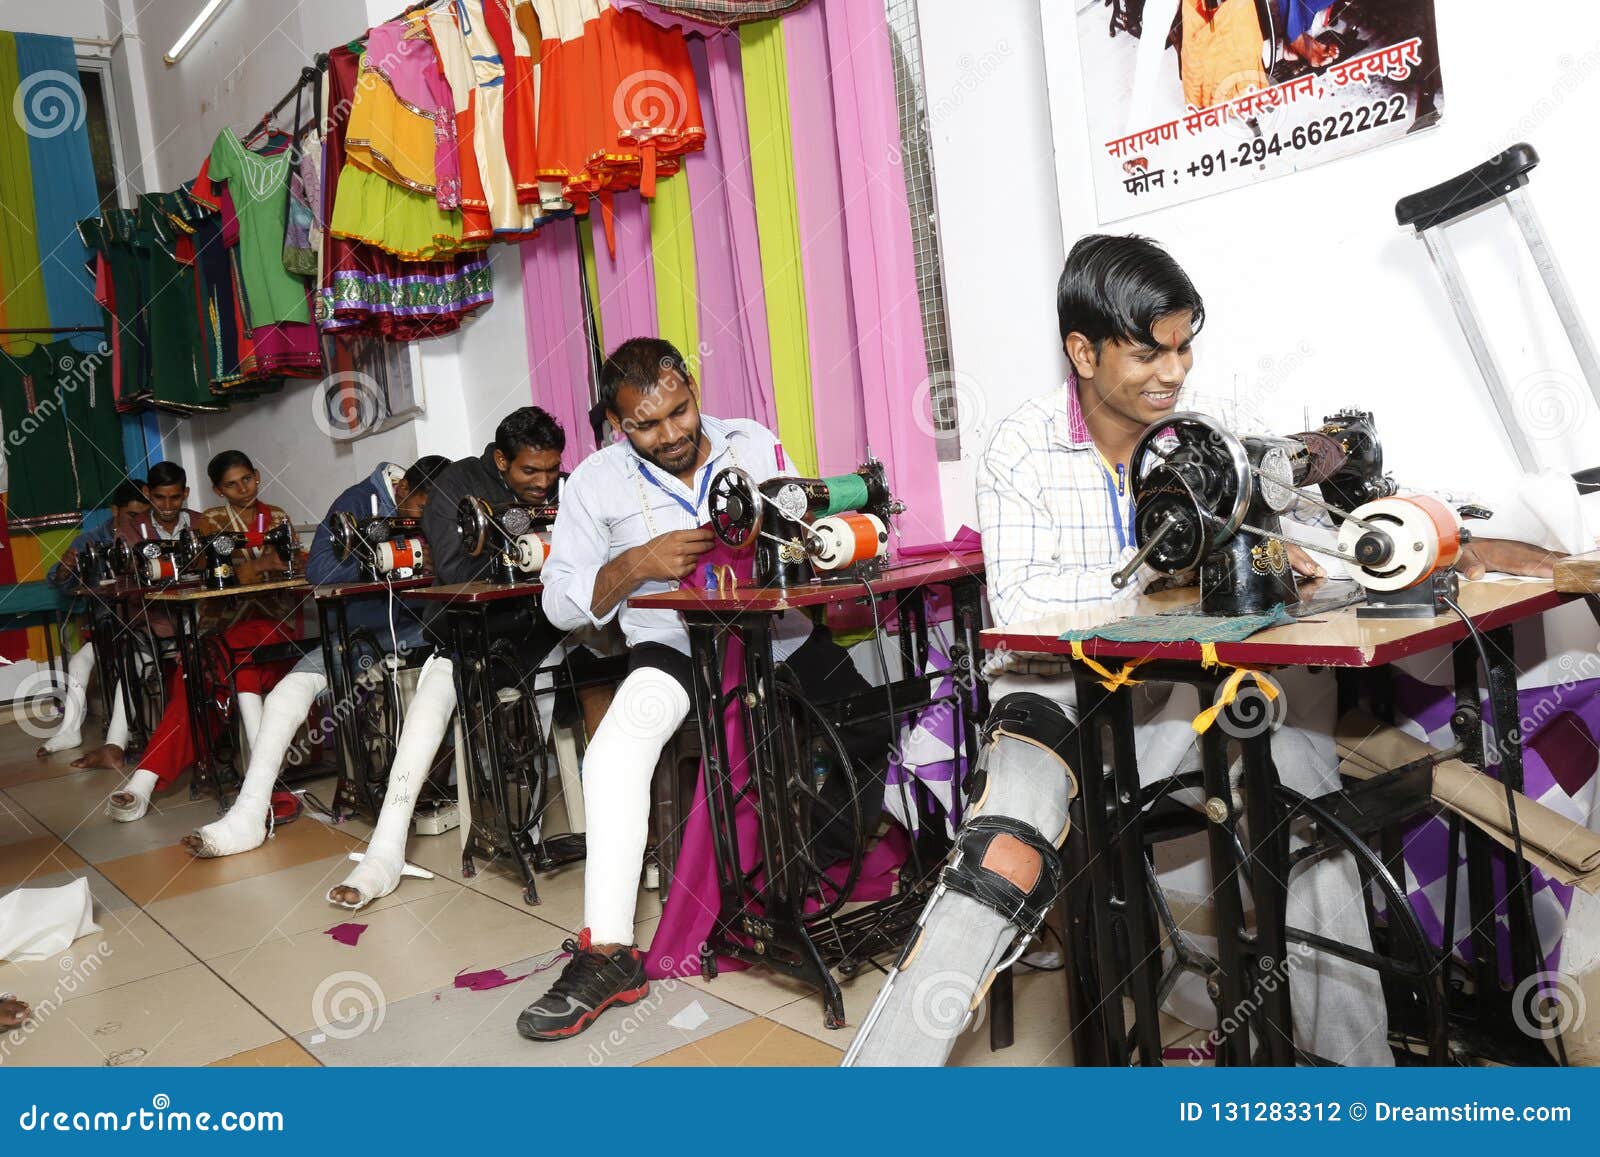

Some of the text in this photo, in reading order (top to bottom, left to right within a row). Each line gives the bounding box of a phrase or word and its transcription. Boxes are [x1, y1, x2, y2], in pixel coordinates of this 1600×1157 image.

[1105, 120, 1180, 158] नारायण
[1183, 105, 1229, 136] सेवा
[1329, 39, 1421, 86] उदयपुर
[1123, 168, 1165, 196] फोन
[1187, 95, 1406, 177] +91-294-6622222
